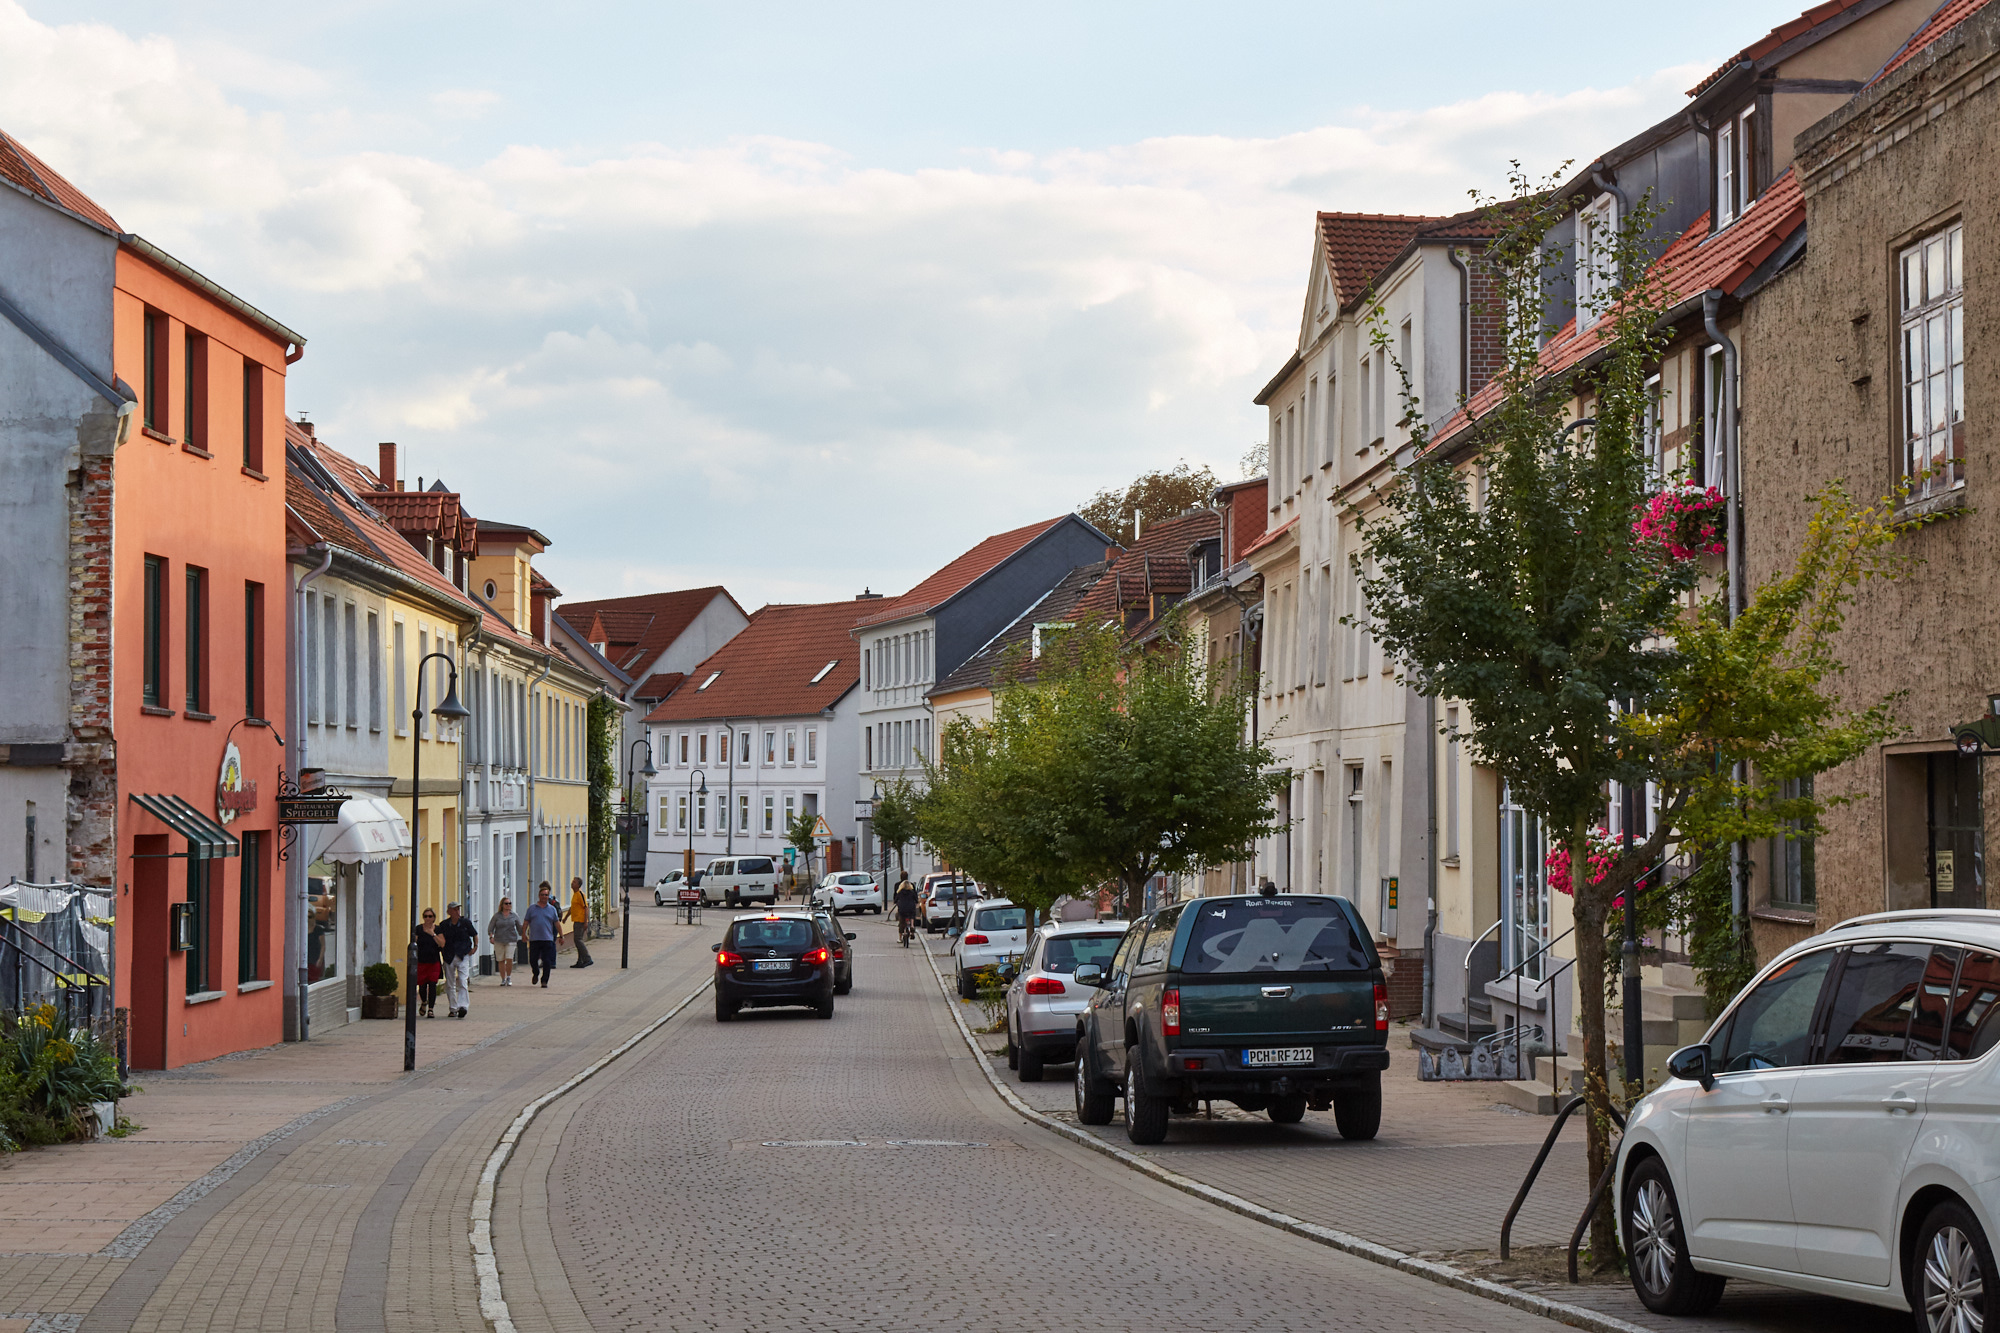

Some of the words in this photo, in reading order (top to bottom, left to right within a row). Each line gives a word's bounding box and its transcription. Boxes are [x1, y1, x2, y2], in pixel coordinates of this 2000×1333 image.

[286, 808, 335, 818] SPIEGELEI
[1249, 1050, 1270, 1062] PCH
[1278, 1050, 1291, 1061] RF
[1293, 1049, 1312, 1061] 212
